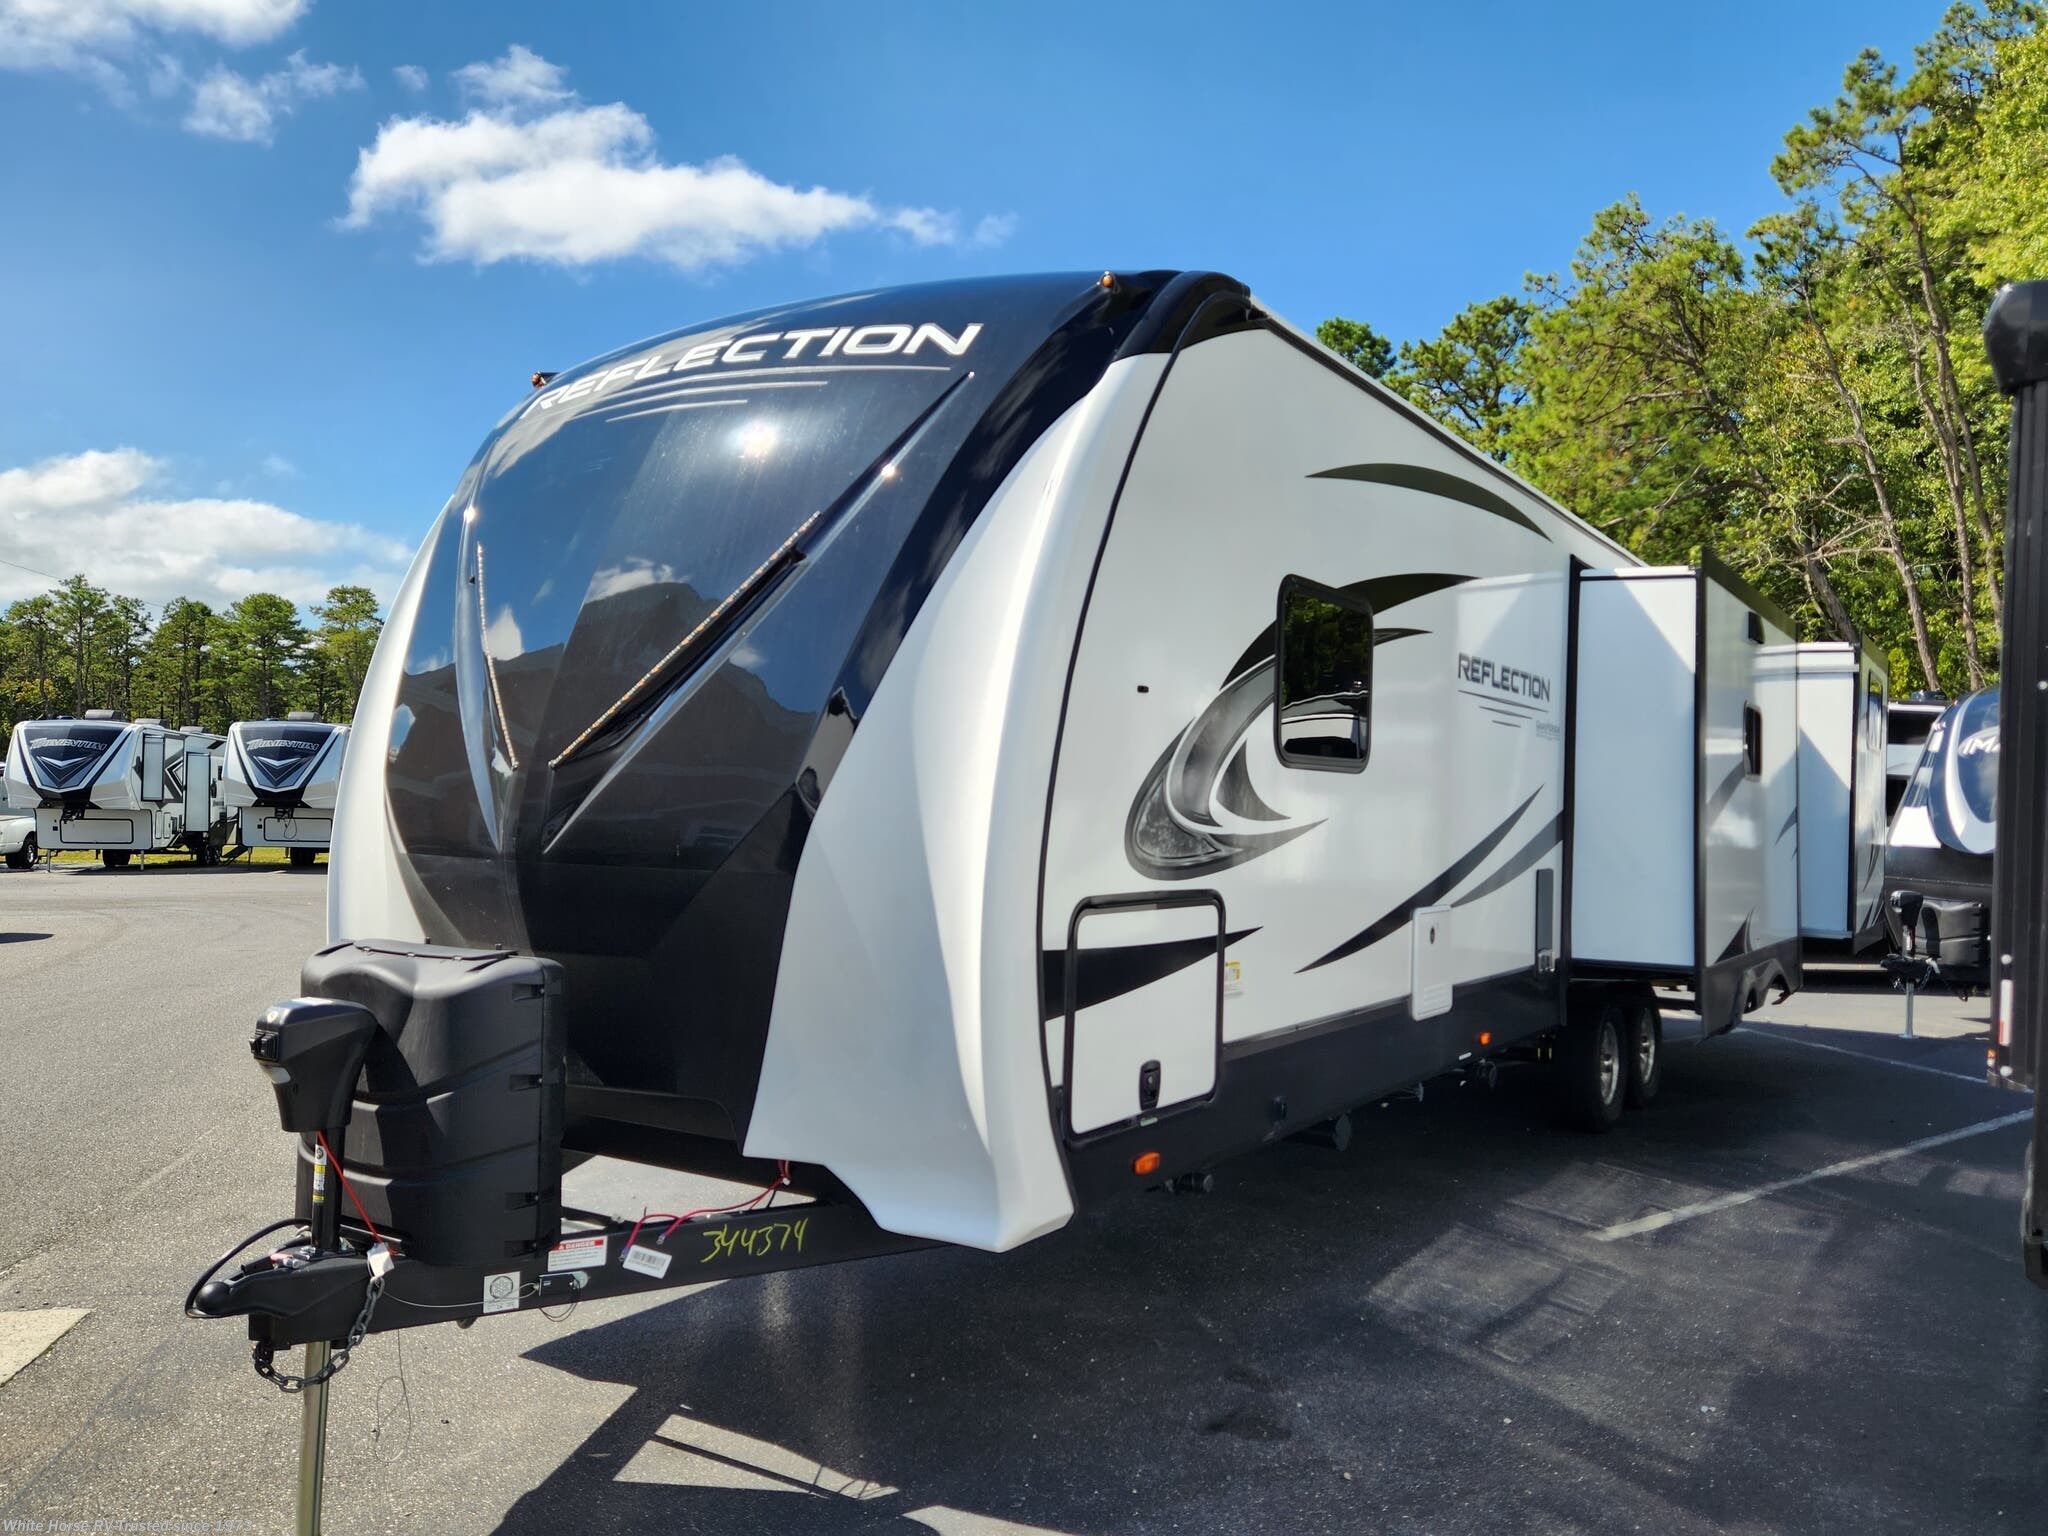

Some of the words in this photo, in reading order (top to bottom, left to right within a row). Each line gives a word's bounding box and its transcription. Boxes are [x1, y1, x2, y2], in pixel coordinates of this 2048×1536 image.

[519, 322, 985, 420] REFLECTION
[1457, 652, 1551, 702] REFLECTION
[700, 1217, 809, 1263] 344374
